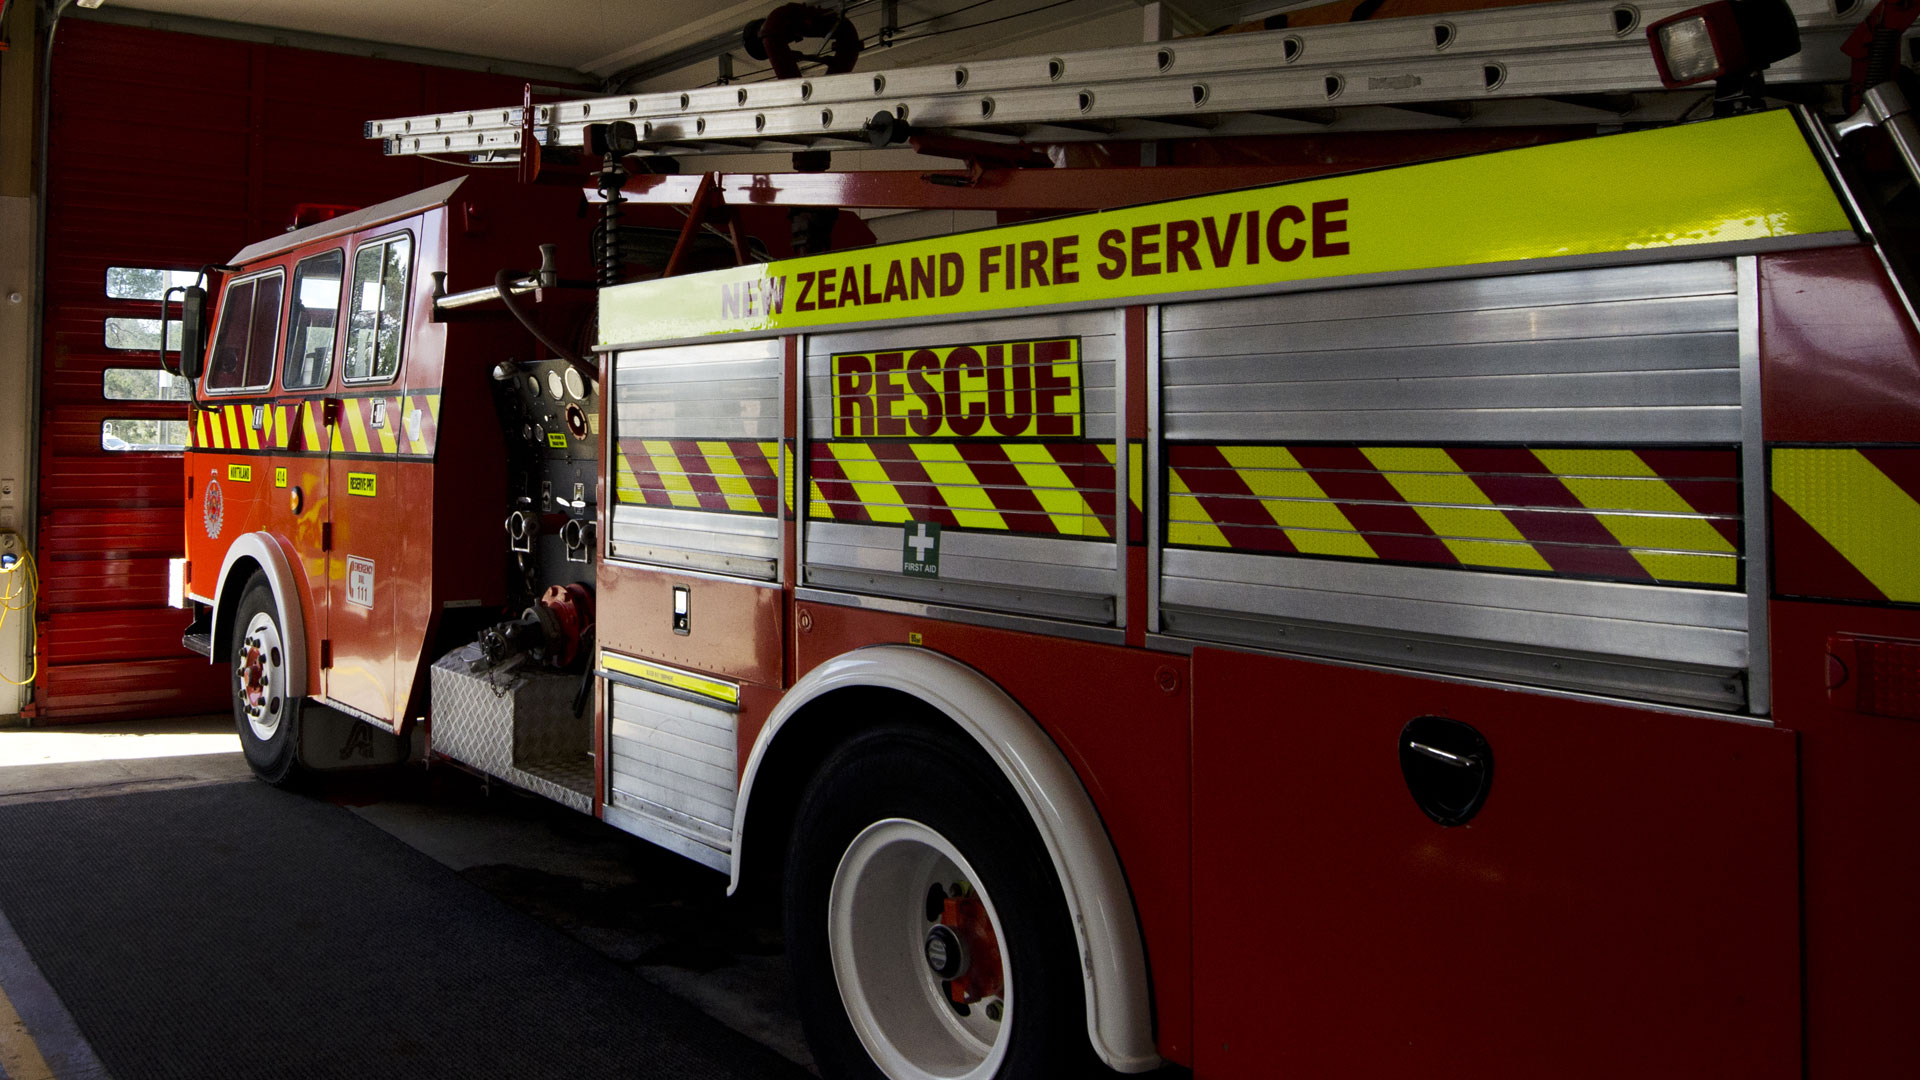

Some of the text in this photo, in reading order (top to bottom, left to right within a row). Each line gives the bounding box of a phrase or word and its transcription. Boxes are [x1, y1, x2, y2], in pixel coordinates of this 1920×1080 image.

[721, 198, 1350, 320] NEW ZEALAND FIRE SERVICE
[837, 341, 1075, 437] RESCUE
[230, 466, 250, 480] NORTHLAND
[350, 477, 366, 491] RESERVE
[354, 562, 373, 574] EMERGENCY
[904, 562, 937, 573] FIRST AID
[357, 586, 368, 601] 111
